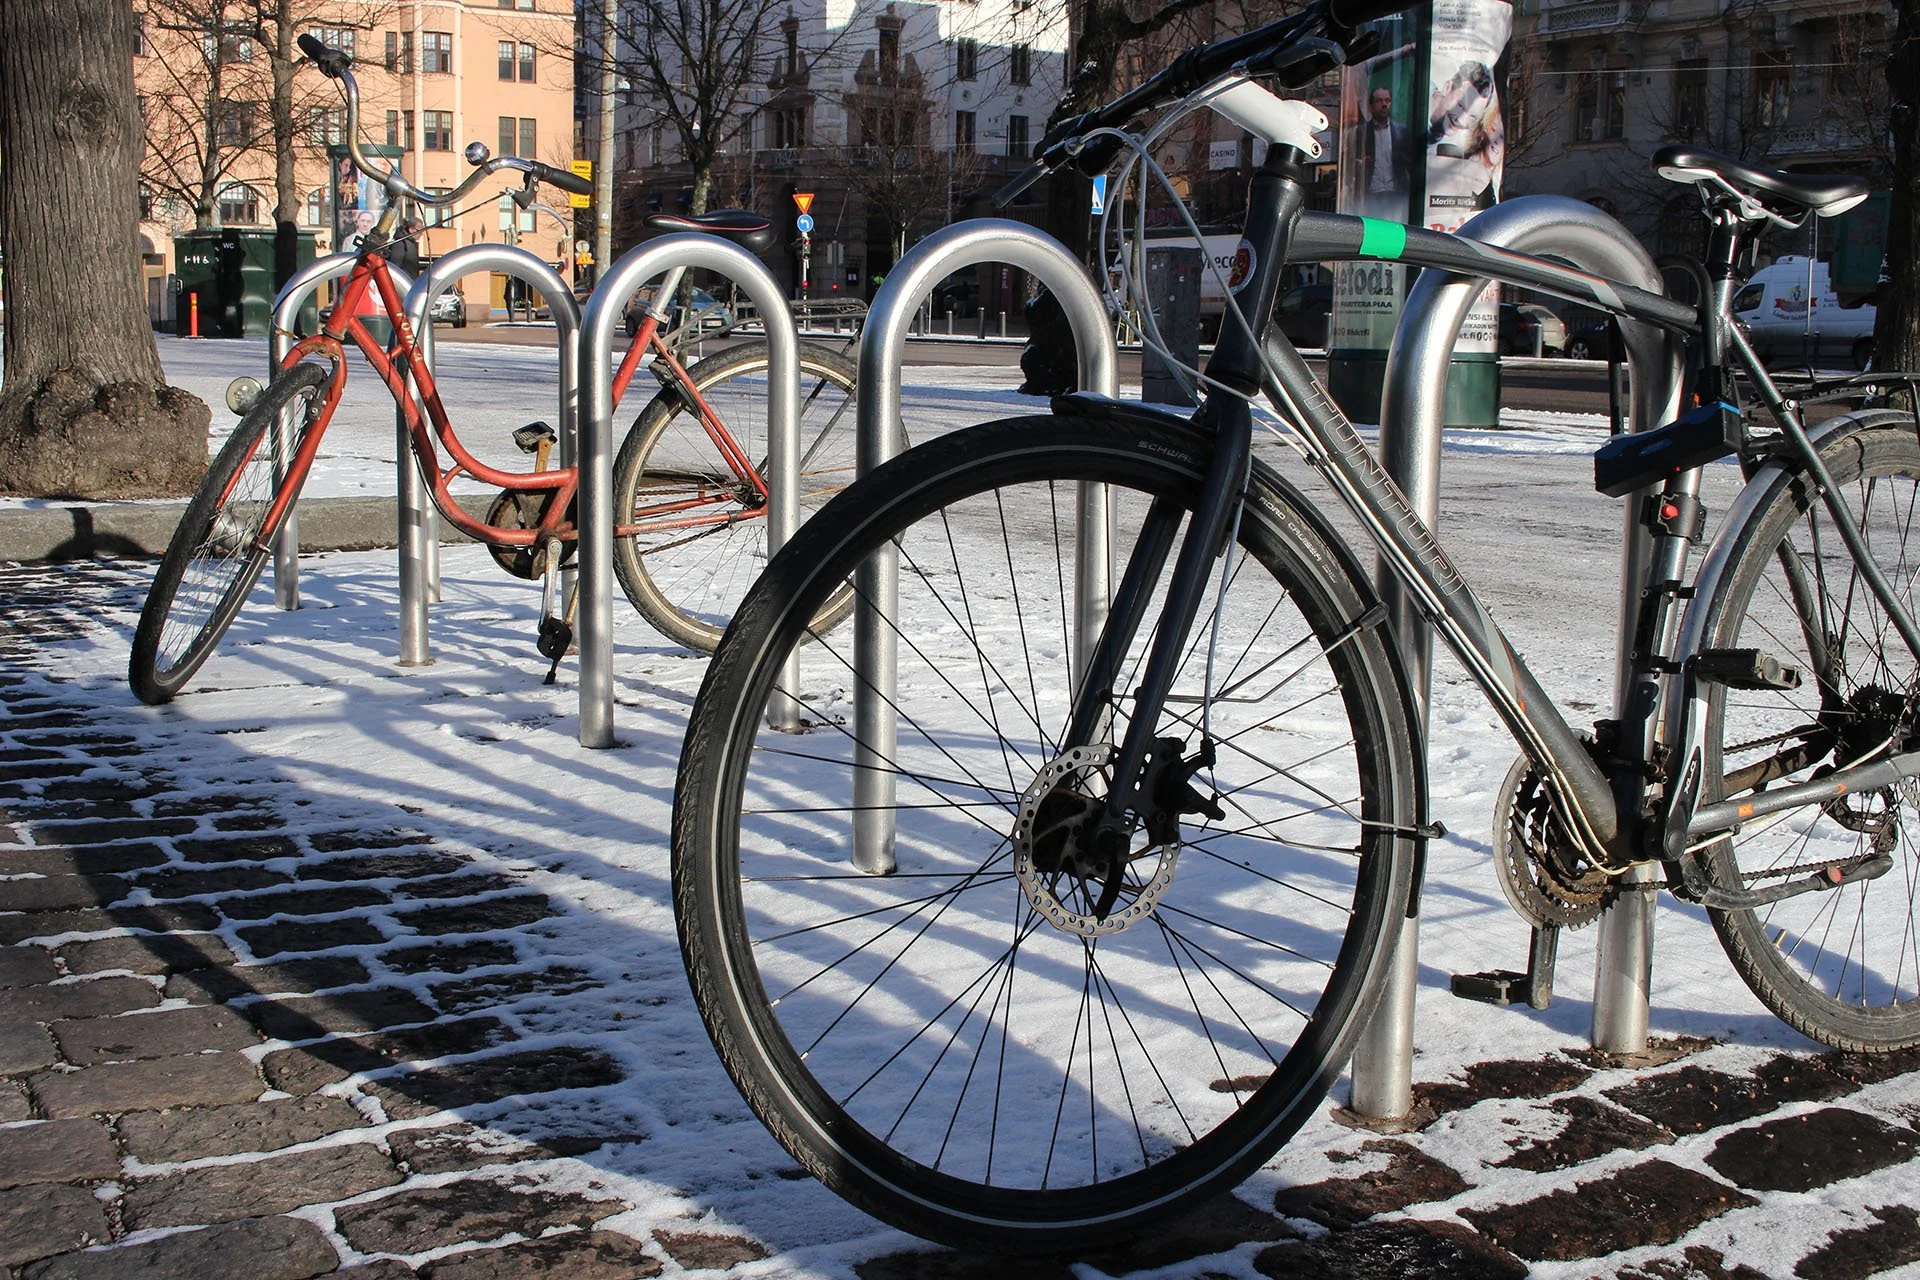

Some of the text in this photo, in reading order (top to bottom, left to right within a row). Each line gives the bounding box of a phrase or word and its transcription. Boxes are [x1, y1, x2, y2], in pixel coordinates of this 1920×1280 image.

[1211, 150, 1235, 158] CASINO
[1303, 379, 1465, 597] TUNTURI
[1259, 496, 1322, 562] ROAD CRUISER
